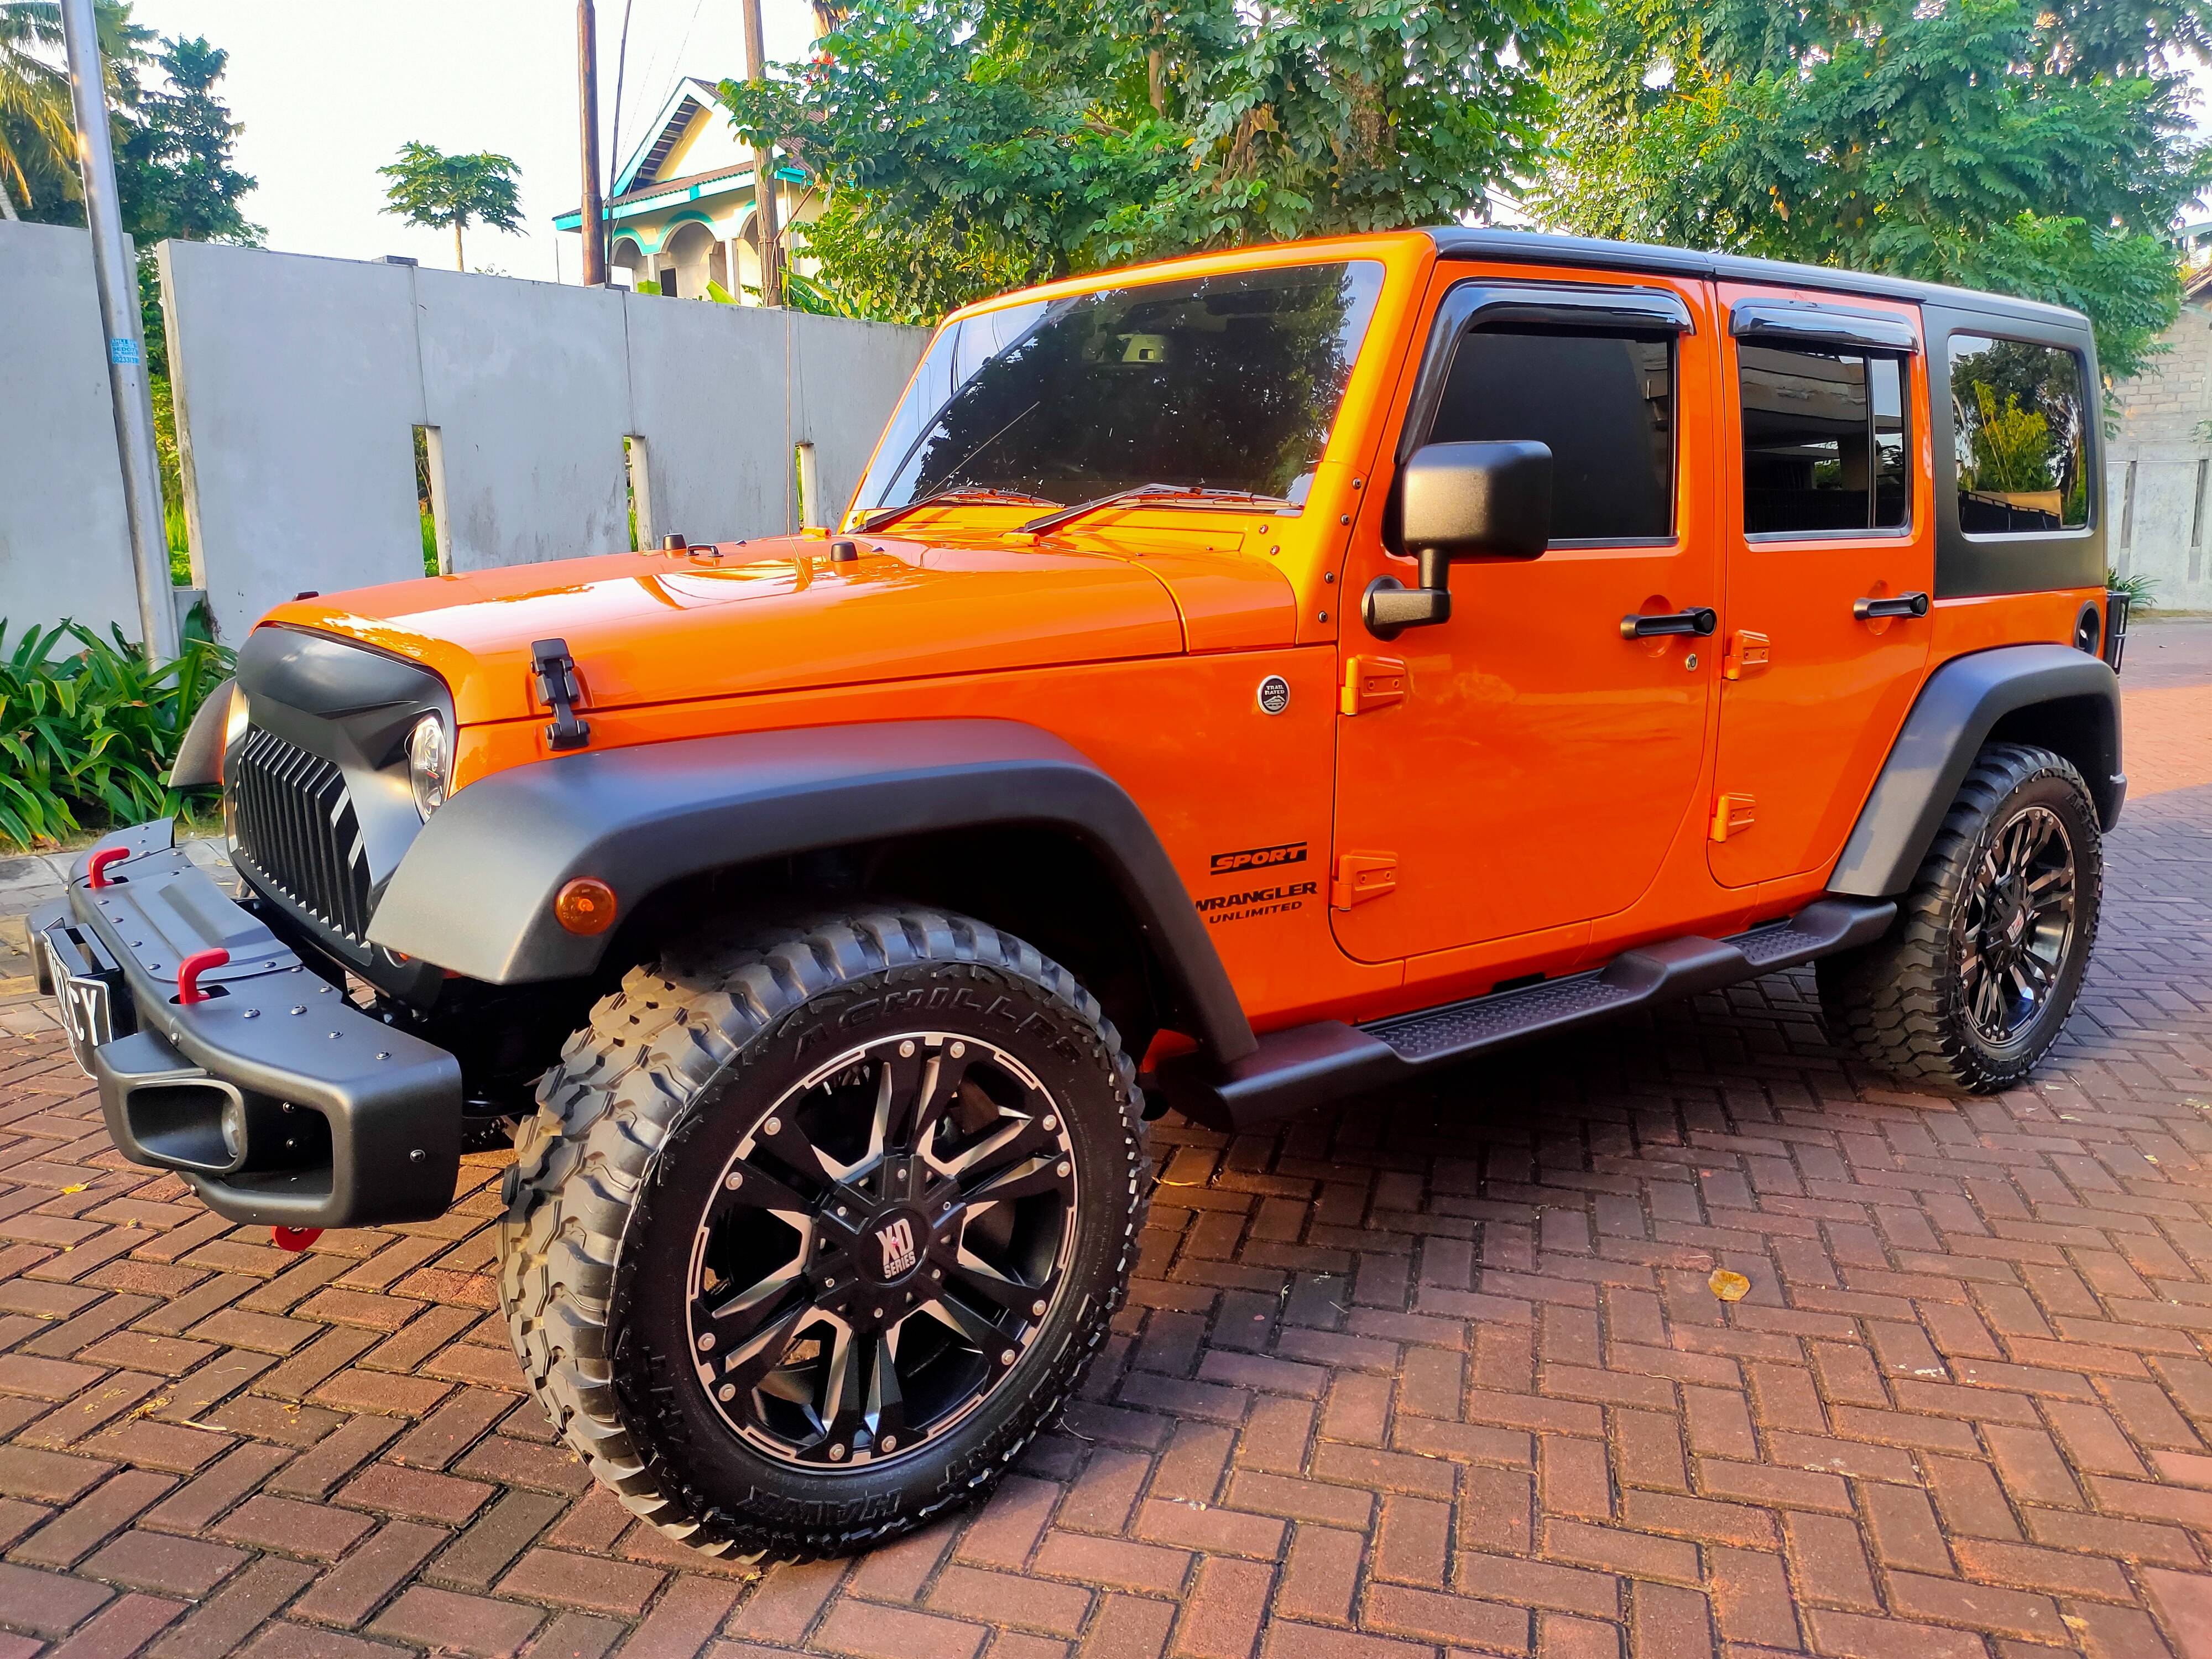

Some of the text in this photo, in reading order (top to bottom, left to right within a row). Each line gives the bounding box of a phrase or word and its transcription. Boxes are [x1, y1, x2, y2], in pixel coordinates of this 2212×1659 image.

[1216, 846, 1307, 870] SPORT
[1196, 881, 1318, 912] WRANGLER
[1209, 901, 1302, 924] UNLIMITED
[794, 988, 1083, 1063] ACHILLES
[874, 1218, 914, 1266] XD
[884, 1251, 916, 1279] SERIES
